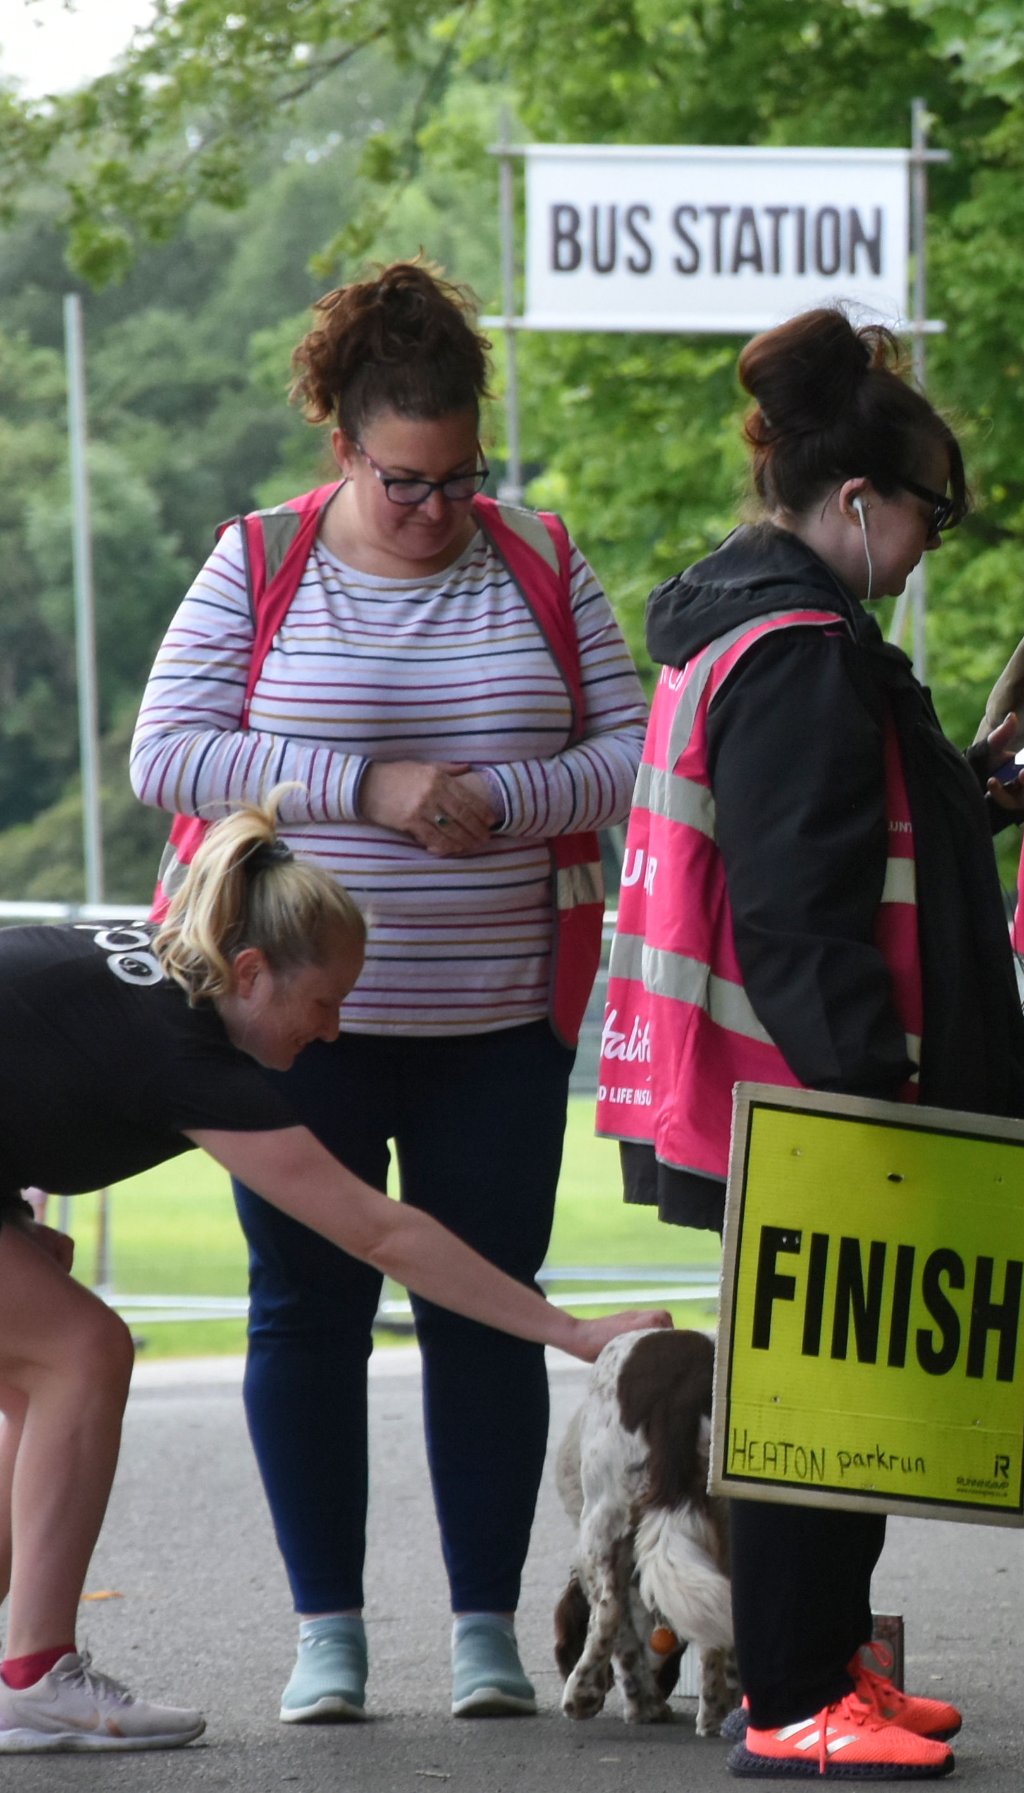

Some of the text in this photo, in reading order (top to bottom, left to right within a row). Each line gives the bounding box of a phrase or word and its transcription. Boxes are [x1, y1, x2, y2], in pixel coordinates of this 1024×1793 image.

[550, 203, 883, 277] BUS STATION
[609, 1087, 633, 1104] LIFE
[751, 1225, 1024, 1383] FINISH
[730, 1428, 927, 1482] HEATON parkrun
